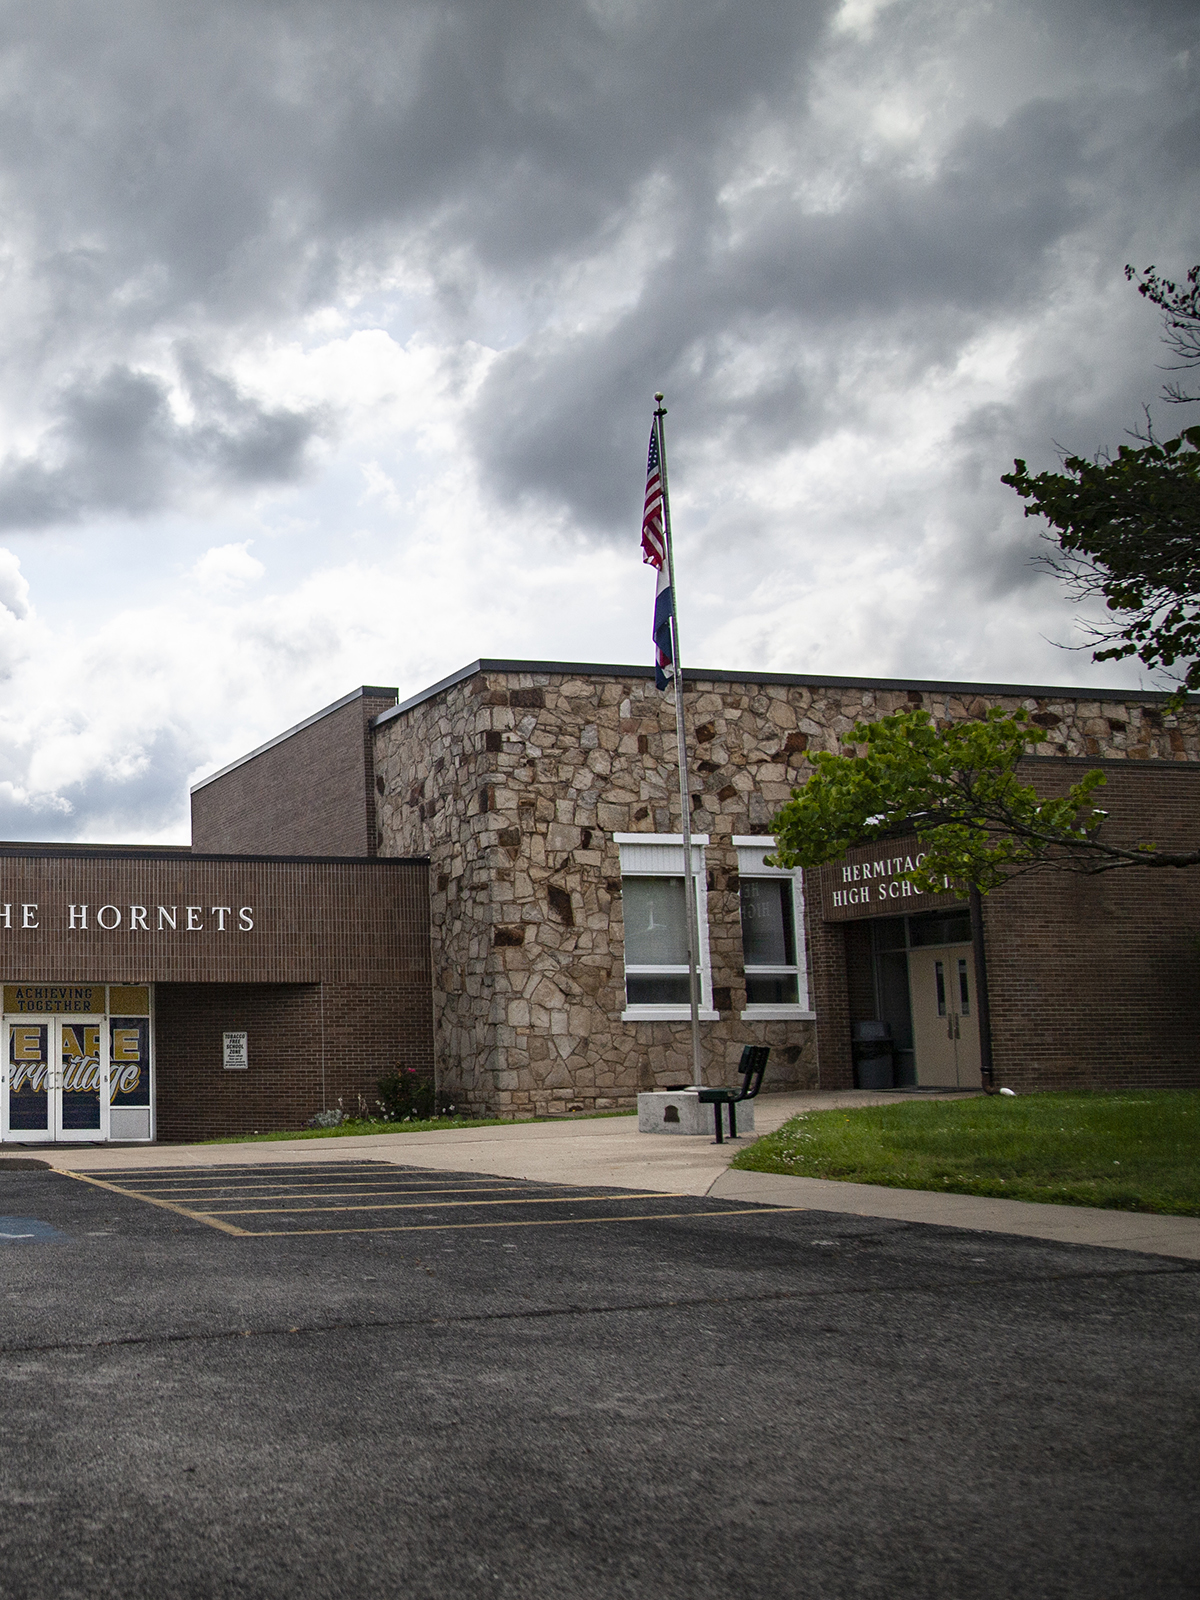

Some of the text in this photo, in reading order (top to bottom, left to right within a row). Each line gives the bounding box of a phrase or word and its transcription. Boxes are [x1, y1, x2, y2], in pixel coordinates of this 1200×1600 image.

[842, 851, 938, 882] HERMITA
[832, 886, 870, 907] HIGH
[68, 905, 255, 932] HORNETS
[16, 988, 93, 999] ACHIEVING
[17, 1000, 91, 1012] TOGETHER
[61, 1026, 141, 1062] ARE
